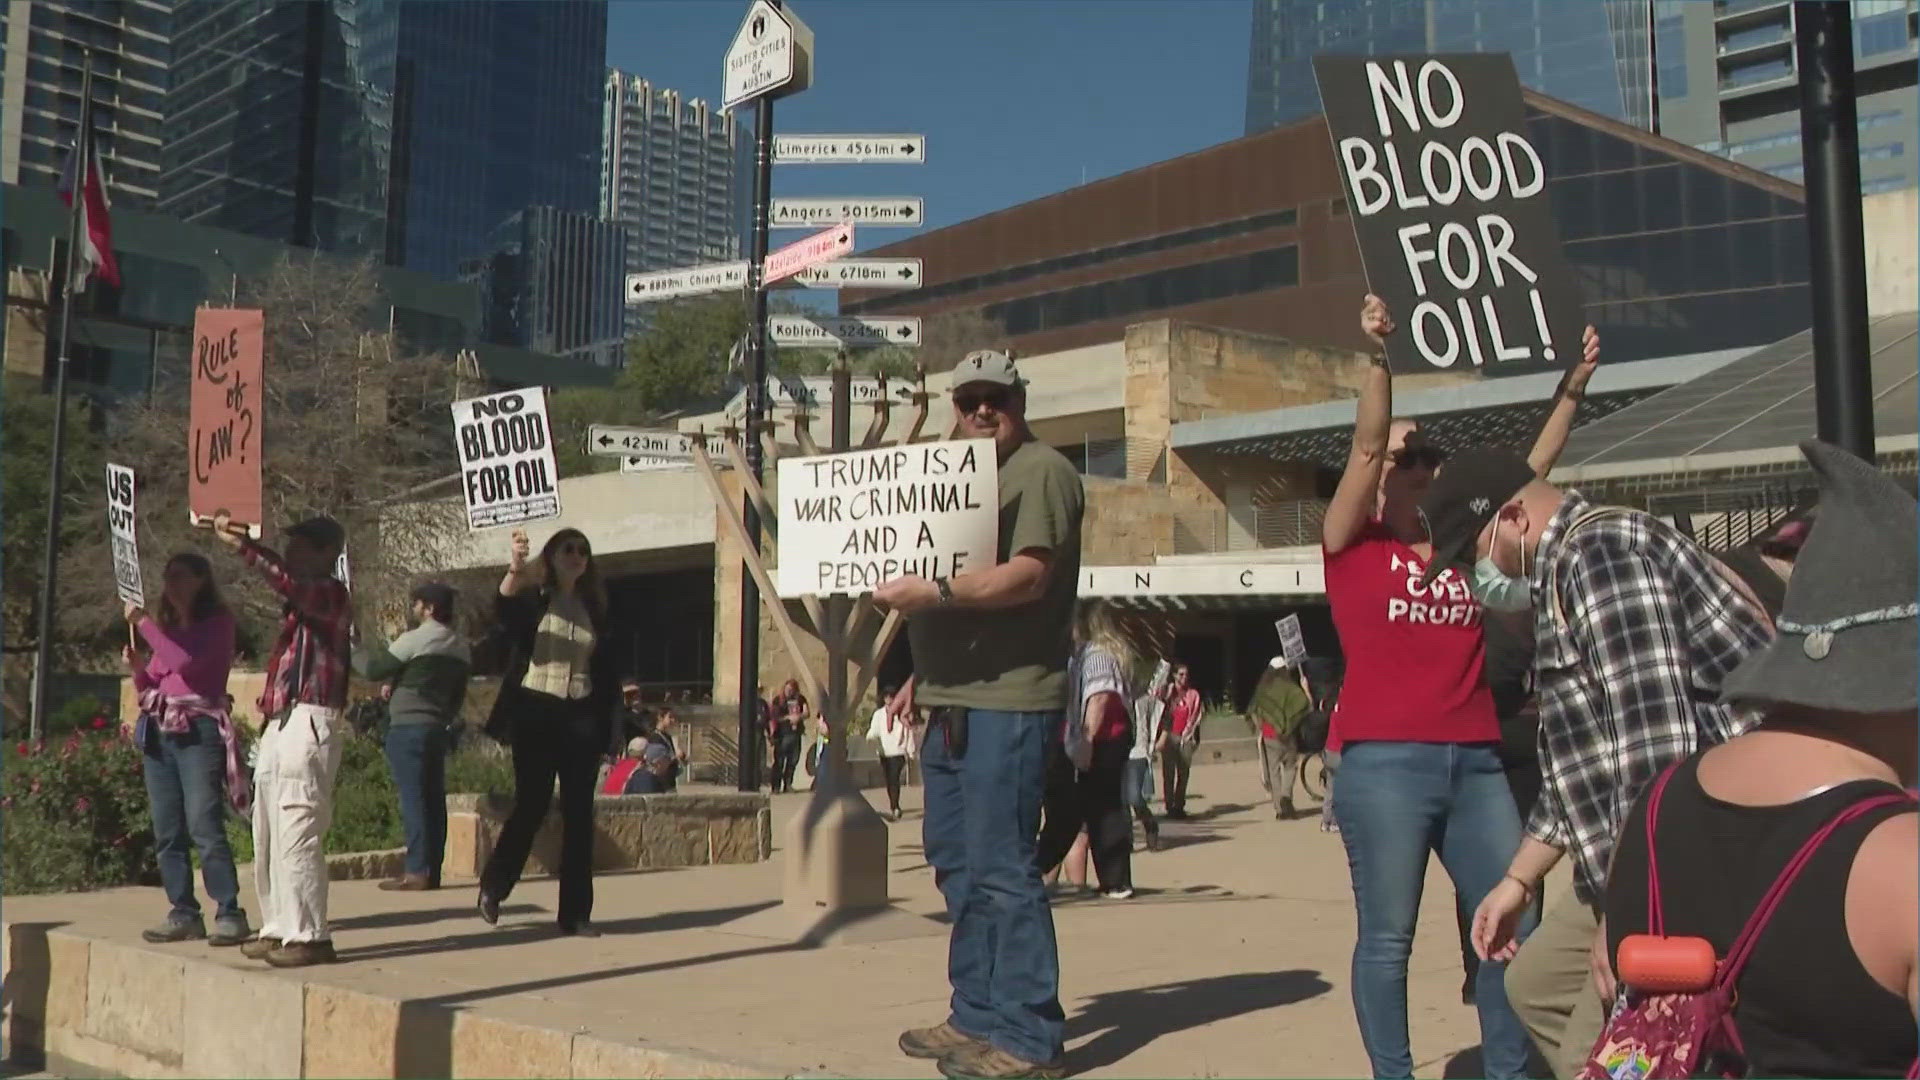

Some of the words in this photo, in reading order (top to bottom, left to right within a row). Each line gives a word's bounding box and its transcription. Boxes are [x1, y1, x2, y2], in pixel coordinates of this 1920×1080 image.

[731, 50, 758, 71] SISTER
[761, 37, 786, 57] CITIES
[752, 60, 763, 74] OF
[742, 69, 772, 92] AUSTIN
[1365, 59, 1465, 138] NO
[778, 143, 838, 155] Limerick
[847, 143, 895, 155] 4561mi
[1339, 132, 1546, 217] BLOOD
[779, 205, 832, 221] Angers
[842, 205, 897, 219] 5015mi
[1397, 214, 1538, 297] FOR
[689, 274, 721, 287] Chiang
[776, 324, 827, 338] Koblenz
[839, 324, 889, 338] 5245mi
[1410, 288, 1556, 368] OIL!
[198, 328, 238, 385] RULE
[226, 370, 248, 413] of
[472, 394, 525, 420] NO
[778, 383, 818, 398] Pune
[195, 408, 253, 484] LAW?
[461, 412, 545, 462] BLOOD
[622, 436, 669, 451] 423mi
[466, 464, 513, 506] FOR
[515, 457, 554, 497] OIL
[803, 451, 908, 488] TRUMP
[923, 448, 949, 475] IS
[959, 444, 977, 473] A
[108, 468, 132, 507] US
[794, 495, 842, 522] WAR
[850, 482, 981, 521] CRIMINAL
[110, 504, 133, 532] OUT
[841, 525, 898, 555] AND
[916, 520, 934, 549] A
